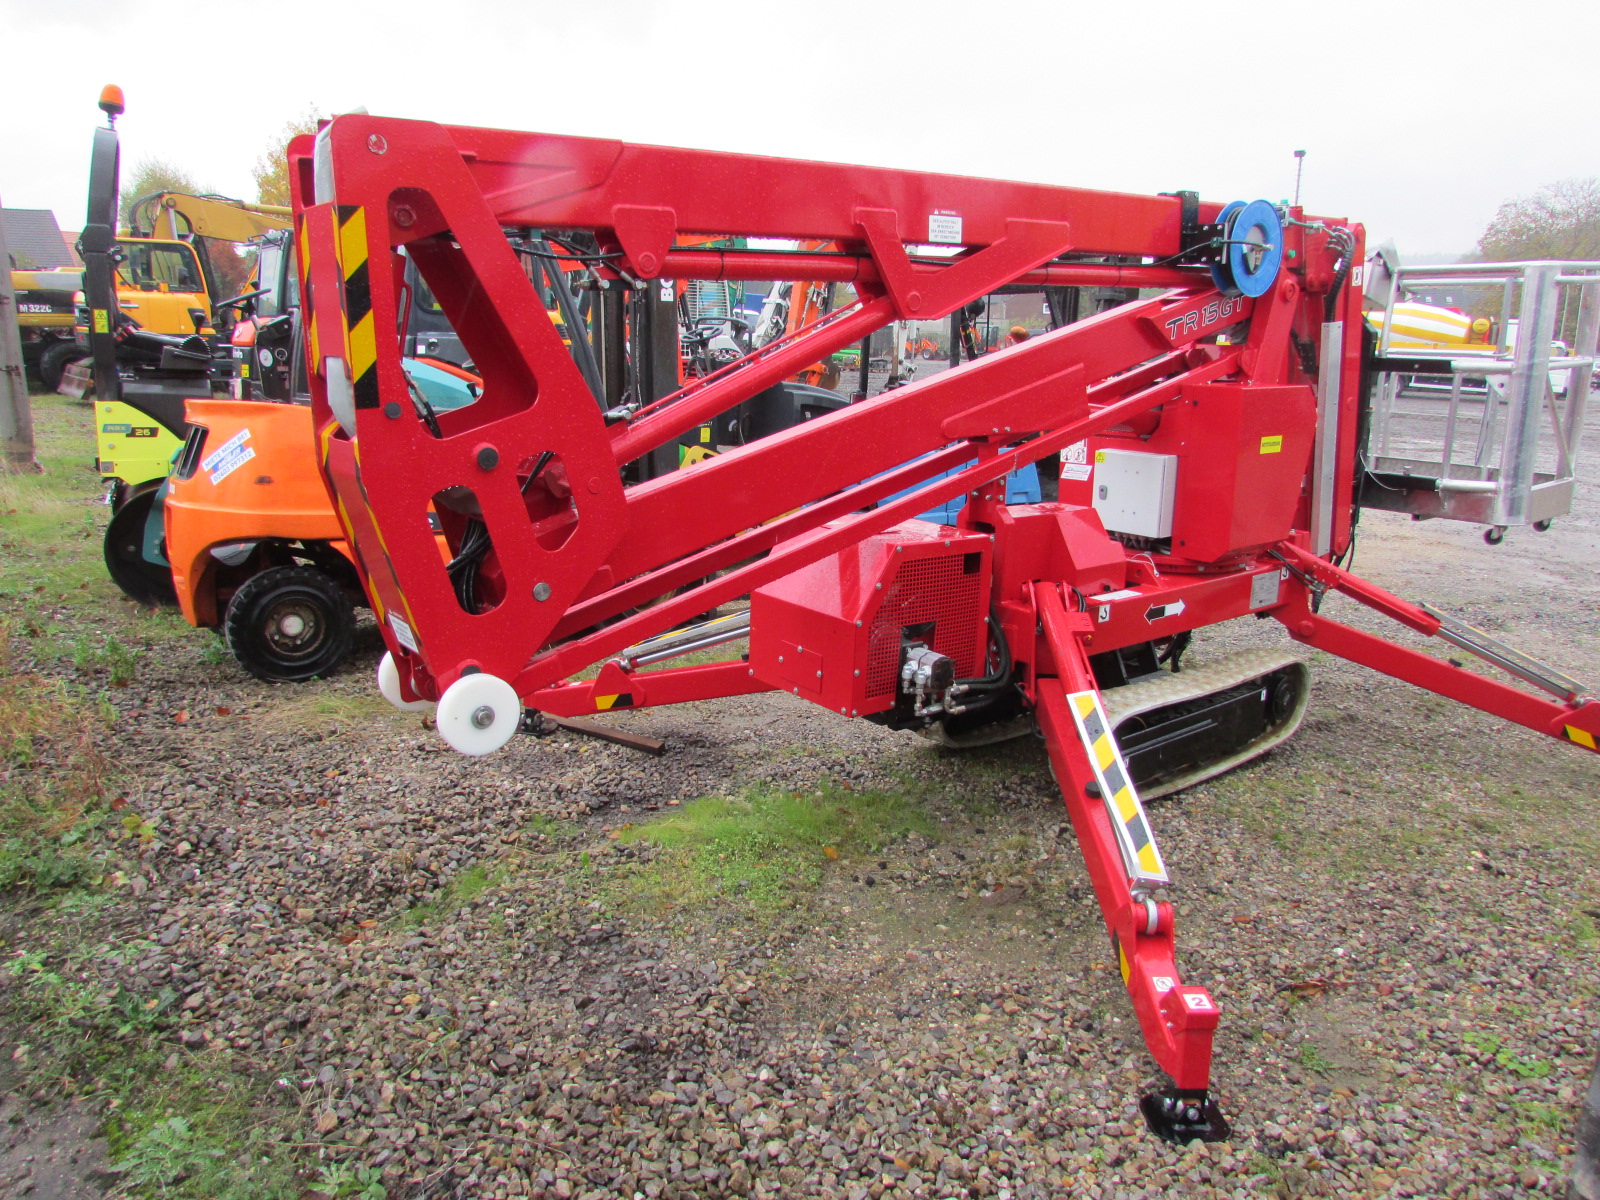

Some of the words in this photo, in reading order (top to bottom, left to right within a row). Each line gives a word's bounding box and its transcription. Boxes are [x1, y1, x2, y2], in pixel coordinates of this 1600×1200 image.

[135, 428, 151, 436] 26
[222, 439, 238, 455] MICH
[1191, 996, 1207, 1007] 2
